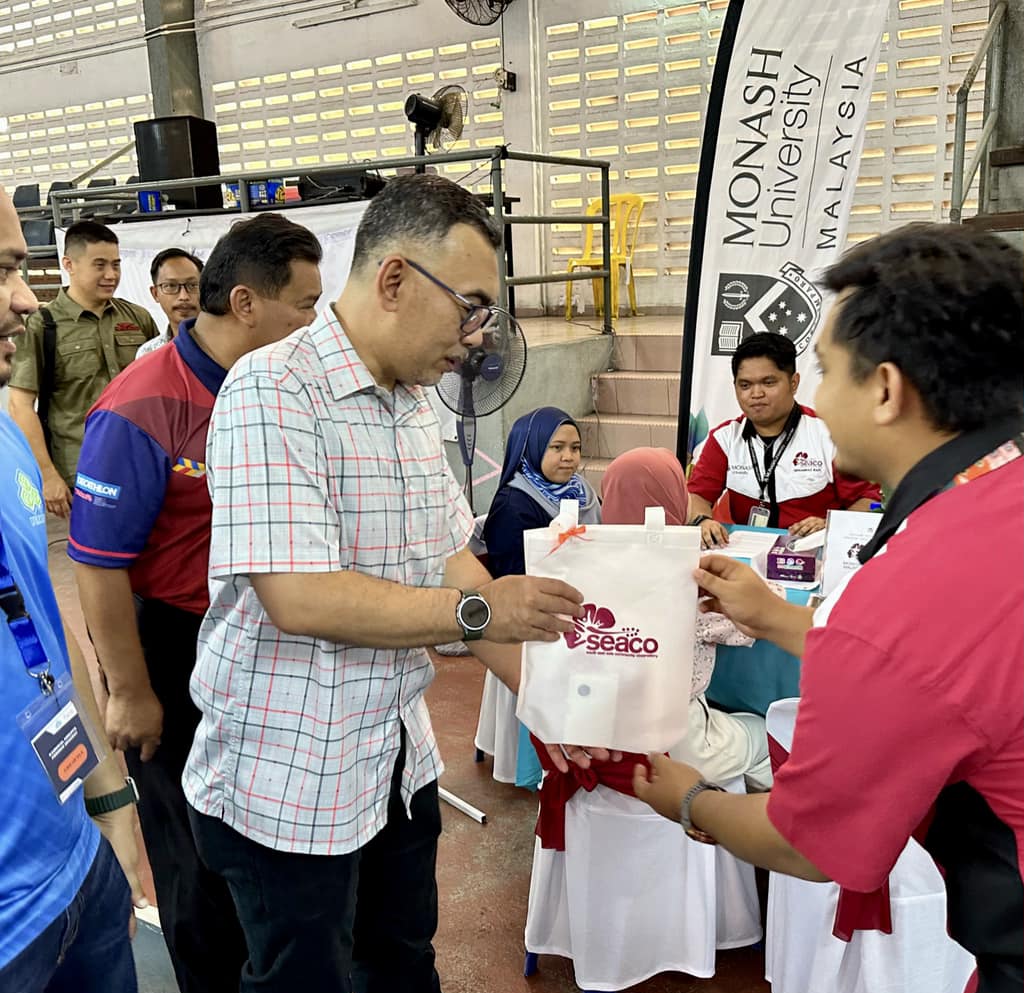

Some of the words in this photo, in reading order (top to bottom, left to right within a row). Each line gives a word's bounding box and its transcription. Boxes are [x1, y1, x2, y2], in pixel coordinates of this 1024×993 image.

[723, 46, 783, 247] MONASH
[759, 64, 821, 247] University
[816, 56, 867, 249] MALAYSIA
[586, 634, 659, 653] seaco
